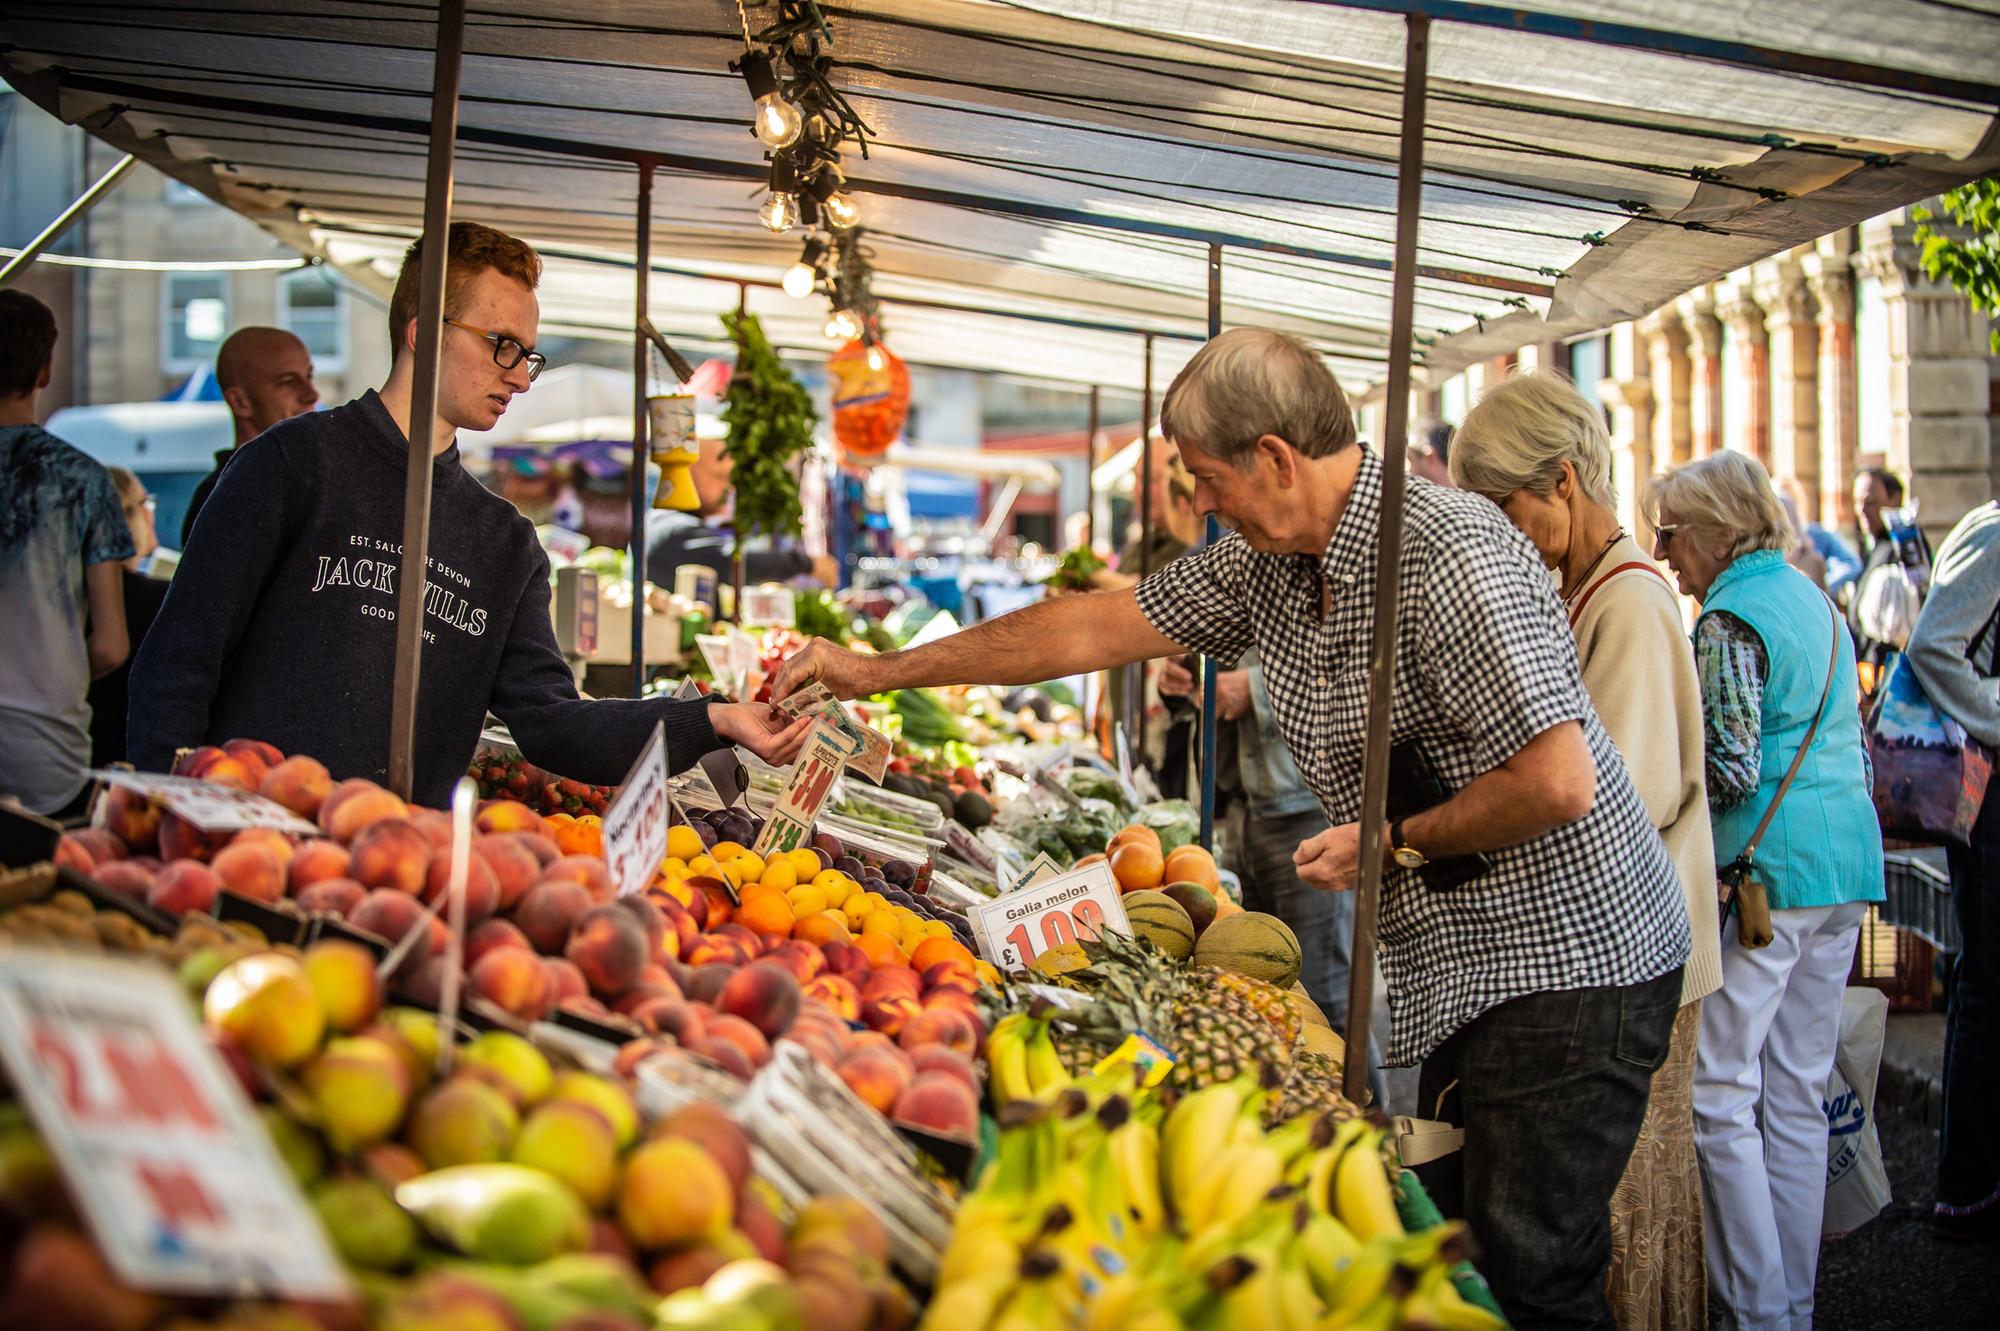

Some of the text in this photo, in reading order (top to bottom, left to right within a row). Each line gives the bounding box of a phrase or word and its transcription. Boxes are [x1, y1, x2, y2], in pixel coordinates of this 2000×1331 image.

[312, 556, 396, 594] JACK
[350, 535, 471, 588] EST. SALCBE DEVON
[361, 604, 395, 621] GOOD
[814, 744, 840, 766] APRICOTS
[1006, 900, 1043, 921] Galia
[1046, 884, 1089, 907] melon
[1826, 1147, 1857, 1182] LUE
